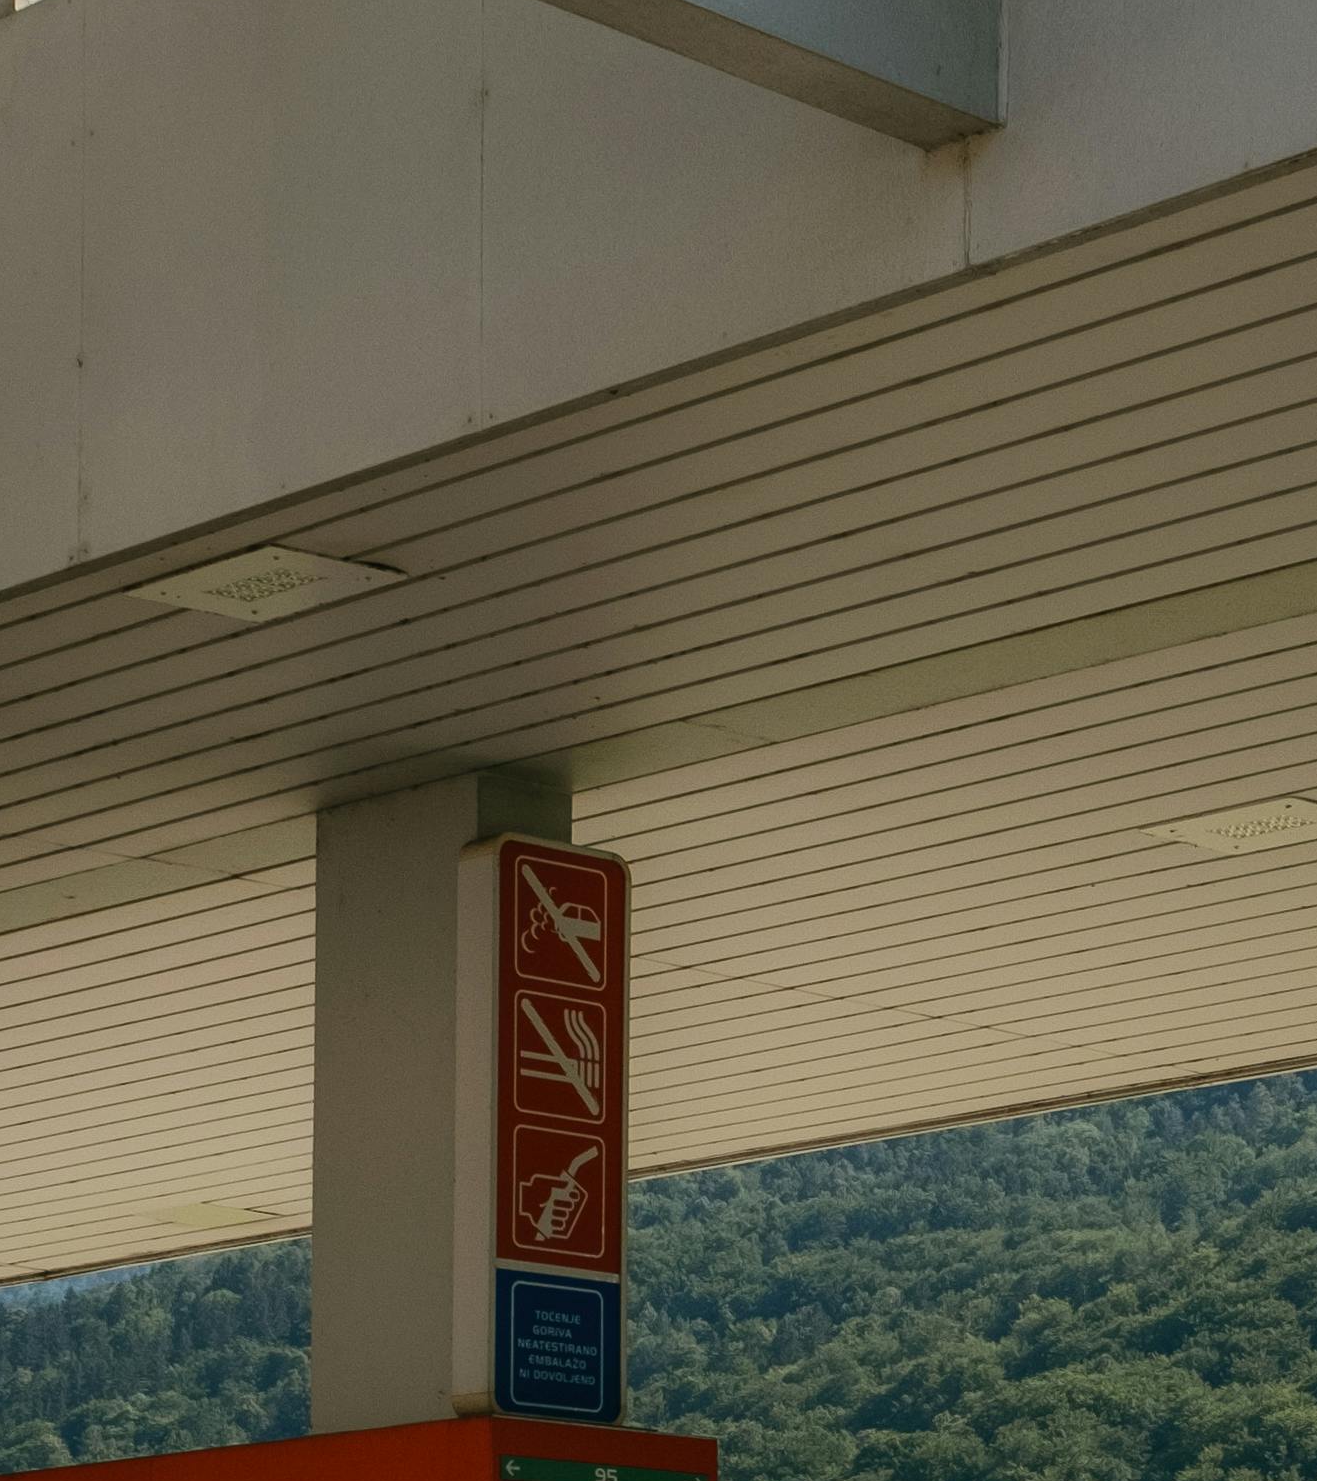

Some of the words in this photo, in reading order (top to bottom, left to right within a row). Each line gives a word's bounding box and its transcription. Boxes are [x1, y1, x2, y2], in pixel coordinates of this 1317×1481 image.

[532, 1325, 573, 1339] GORIVA
[517, 1337, 598, 1357] NEATESTIRANO
[533, 1369, 596, 1386] DOVOLJENO
